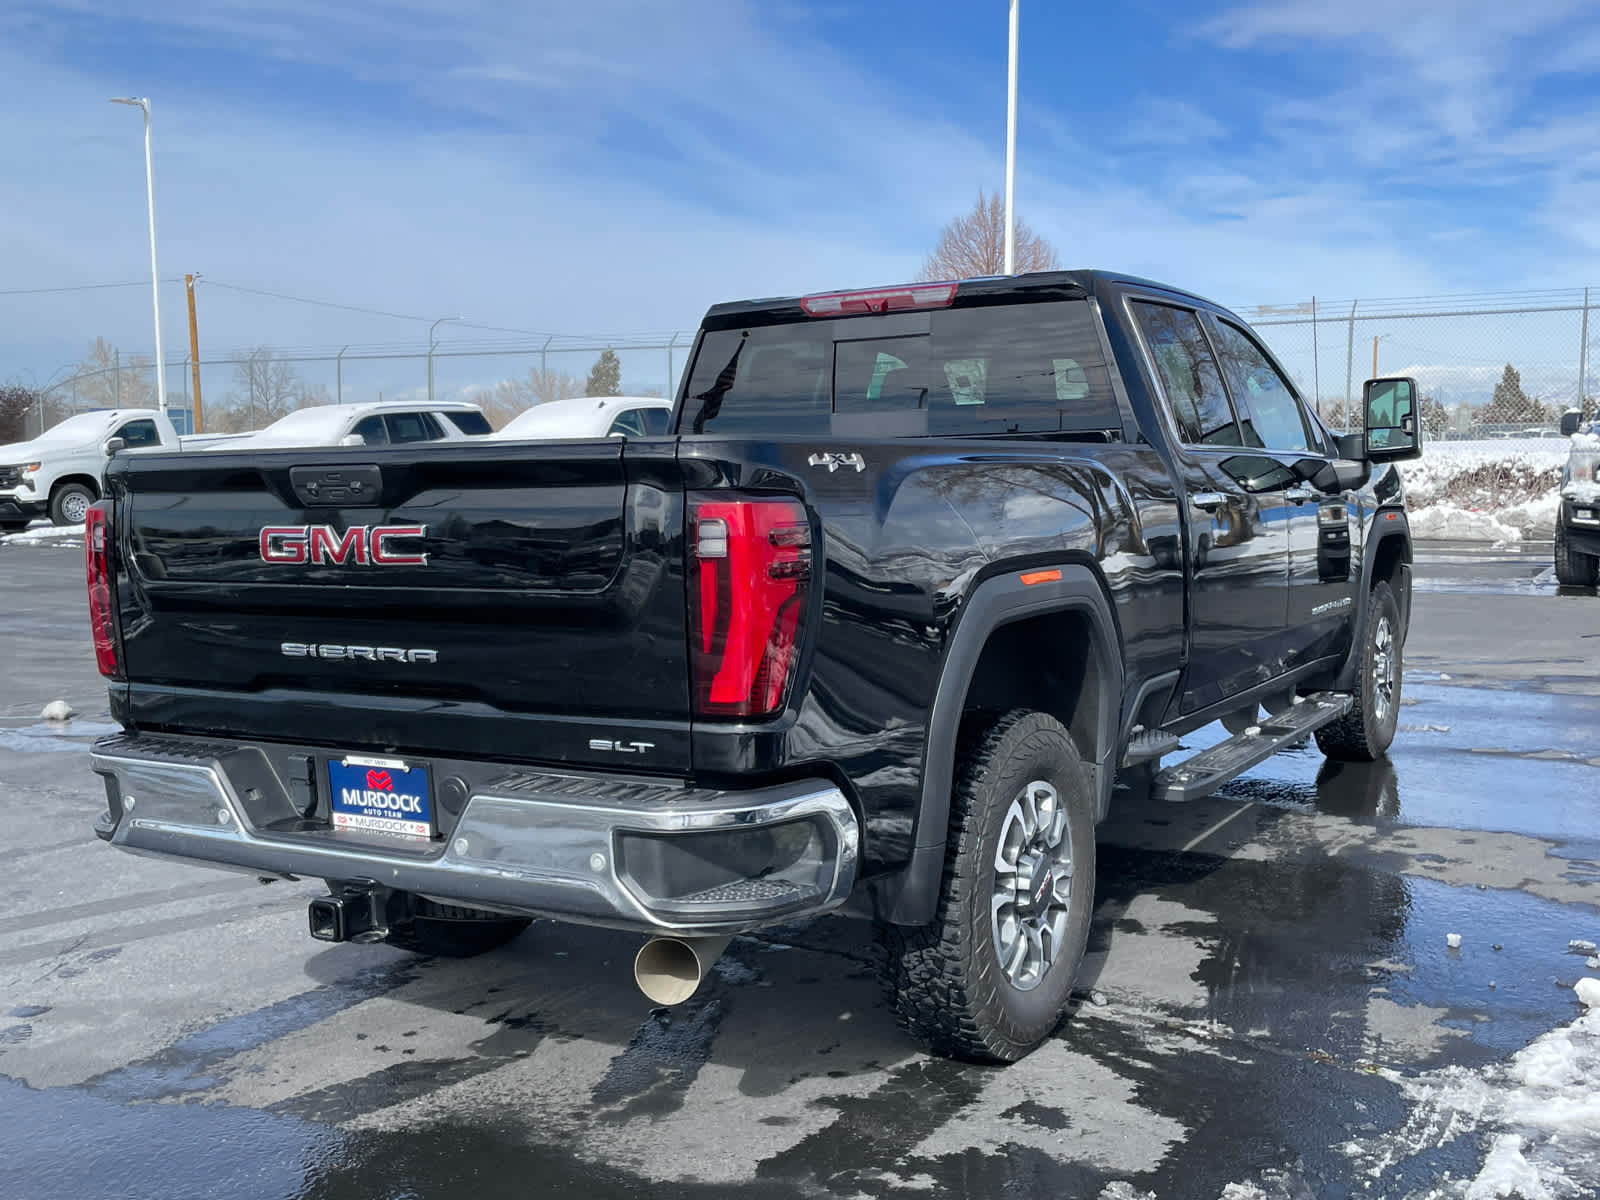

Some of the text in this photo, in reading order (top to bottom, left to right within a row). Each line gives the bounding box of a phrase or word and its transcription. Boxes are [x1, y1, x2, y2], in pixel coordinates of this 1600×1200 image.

[259, 524, 430, 567] GMC
[280, 642, 439, 664] SIERRA
[589, 739, 656, 754] SLT
[342, 788, 422, 814] MURDOCK
[364, 808, 402, 818] AUTO TEAM
[355, 817, 407, 831] MURDOCK
